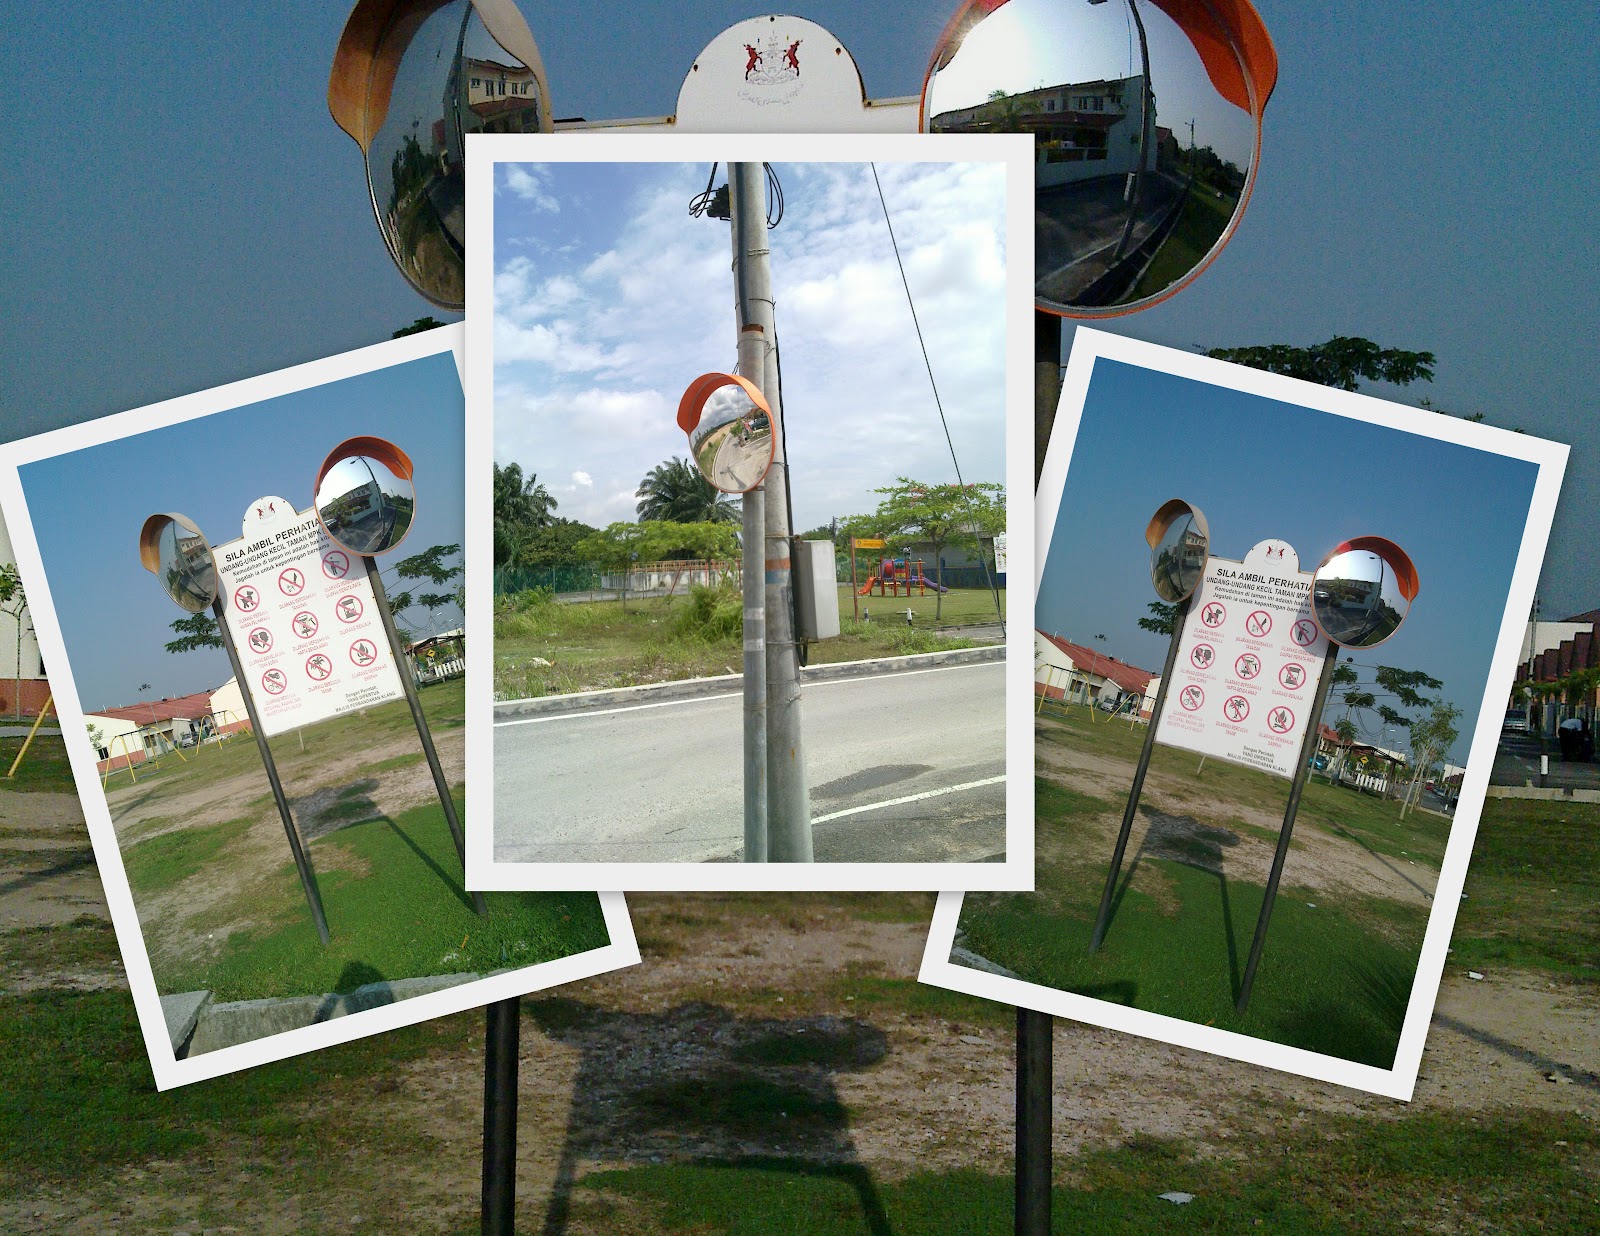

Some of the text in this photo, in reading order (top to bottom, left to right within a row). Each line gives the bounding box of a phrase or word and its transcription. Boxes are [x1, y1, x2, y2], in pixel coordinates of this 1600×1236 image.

[220, 529, 322, 574] UNDANG-UNDANG KECIL TAMAN MPK
[226, 549, 246, 562] SILA
[247, 538, 274, 554] AMBIL
[1217, 568, 1236, 579] SILA
[1238, 572, 1266, 584] AMBIL
[1206, 577, 1310, 600] UNDANG-UNDANG KECIL TAMAN MPK
